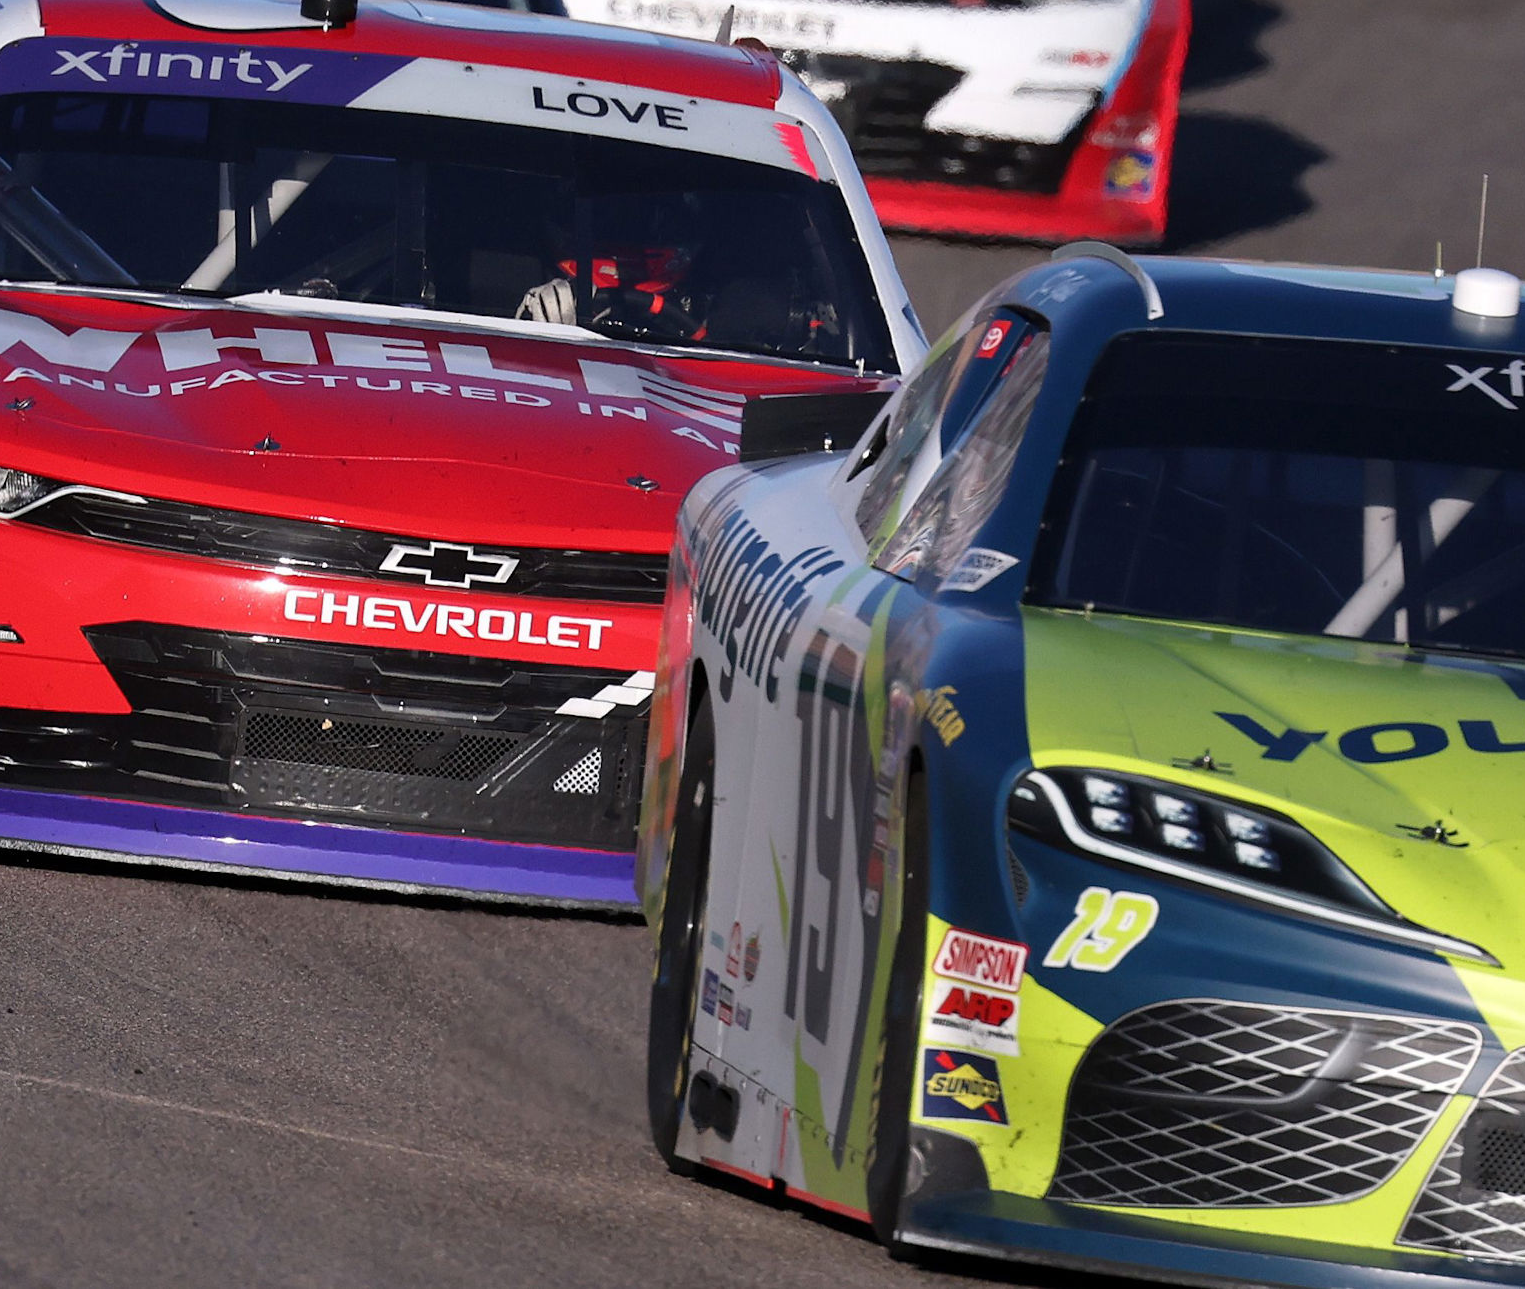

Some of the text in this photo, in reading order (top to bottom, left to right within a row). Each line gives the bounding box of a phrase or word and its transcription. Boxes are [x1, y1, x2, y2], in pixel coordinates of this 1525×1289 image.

[50, 42, 314, 92] xfinity
[532, 86, 689, 132] LOVE
[578, 401, 648, 422] IN
[284, 590, 613, 650] CHEVROLET
[1042, 885, 1160, 973] 19
[942, 935, 1020, 987] SIMPSON
[936, 986, 1015, 1027] ARP
[931, 1076, 1000, 1099] SUNOCO
